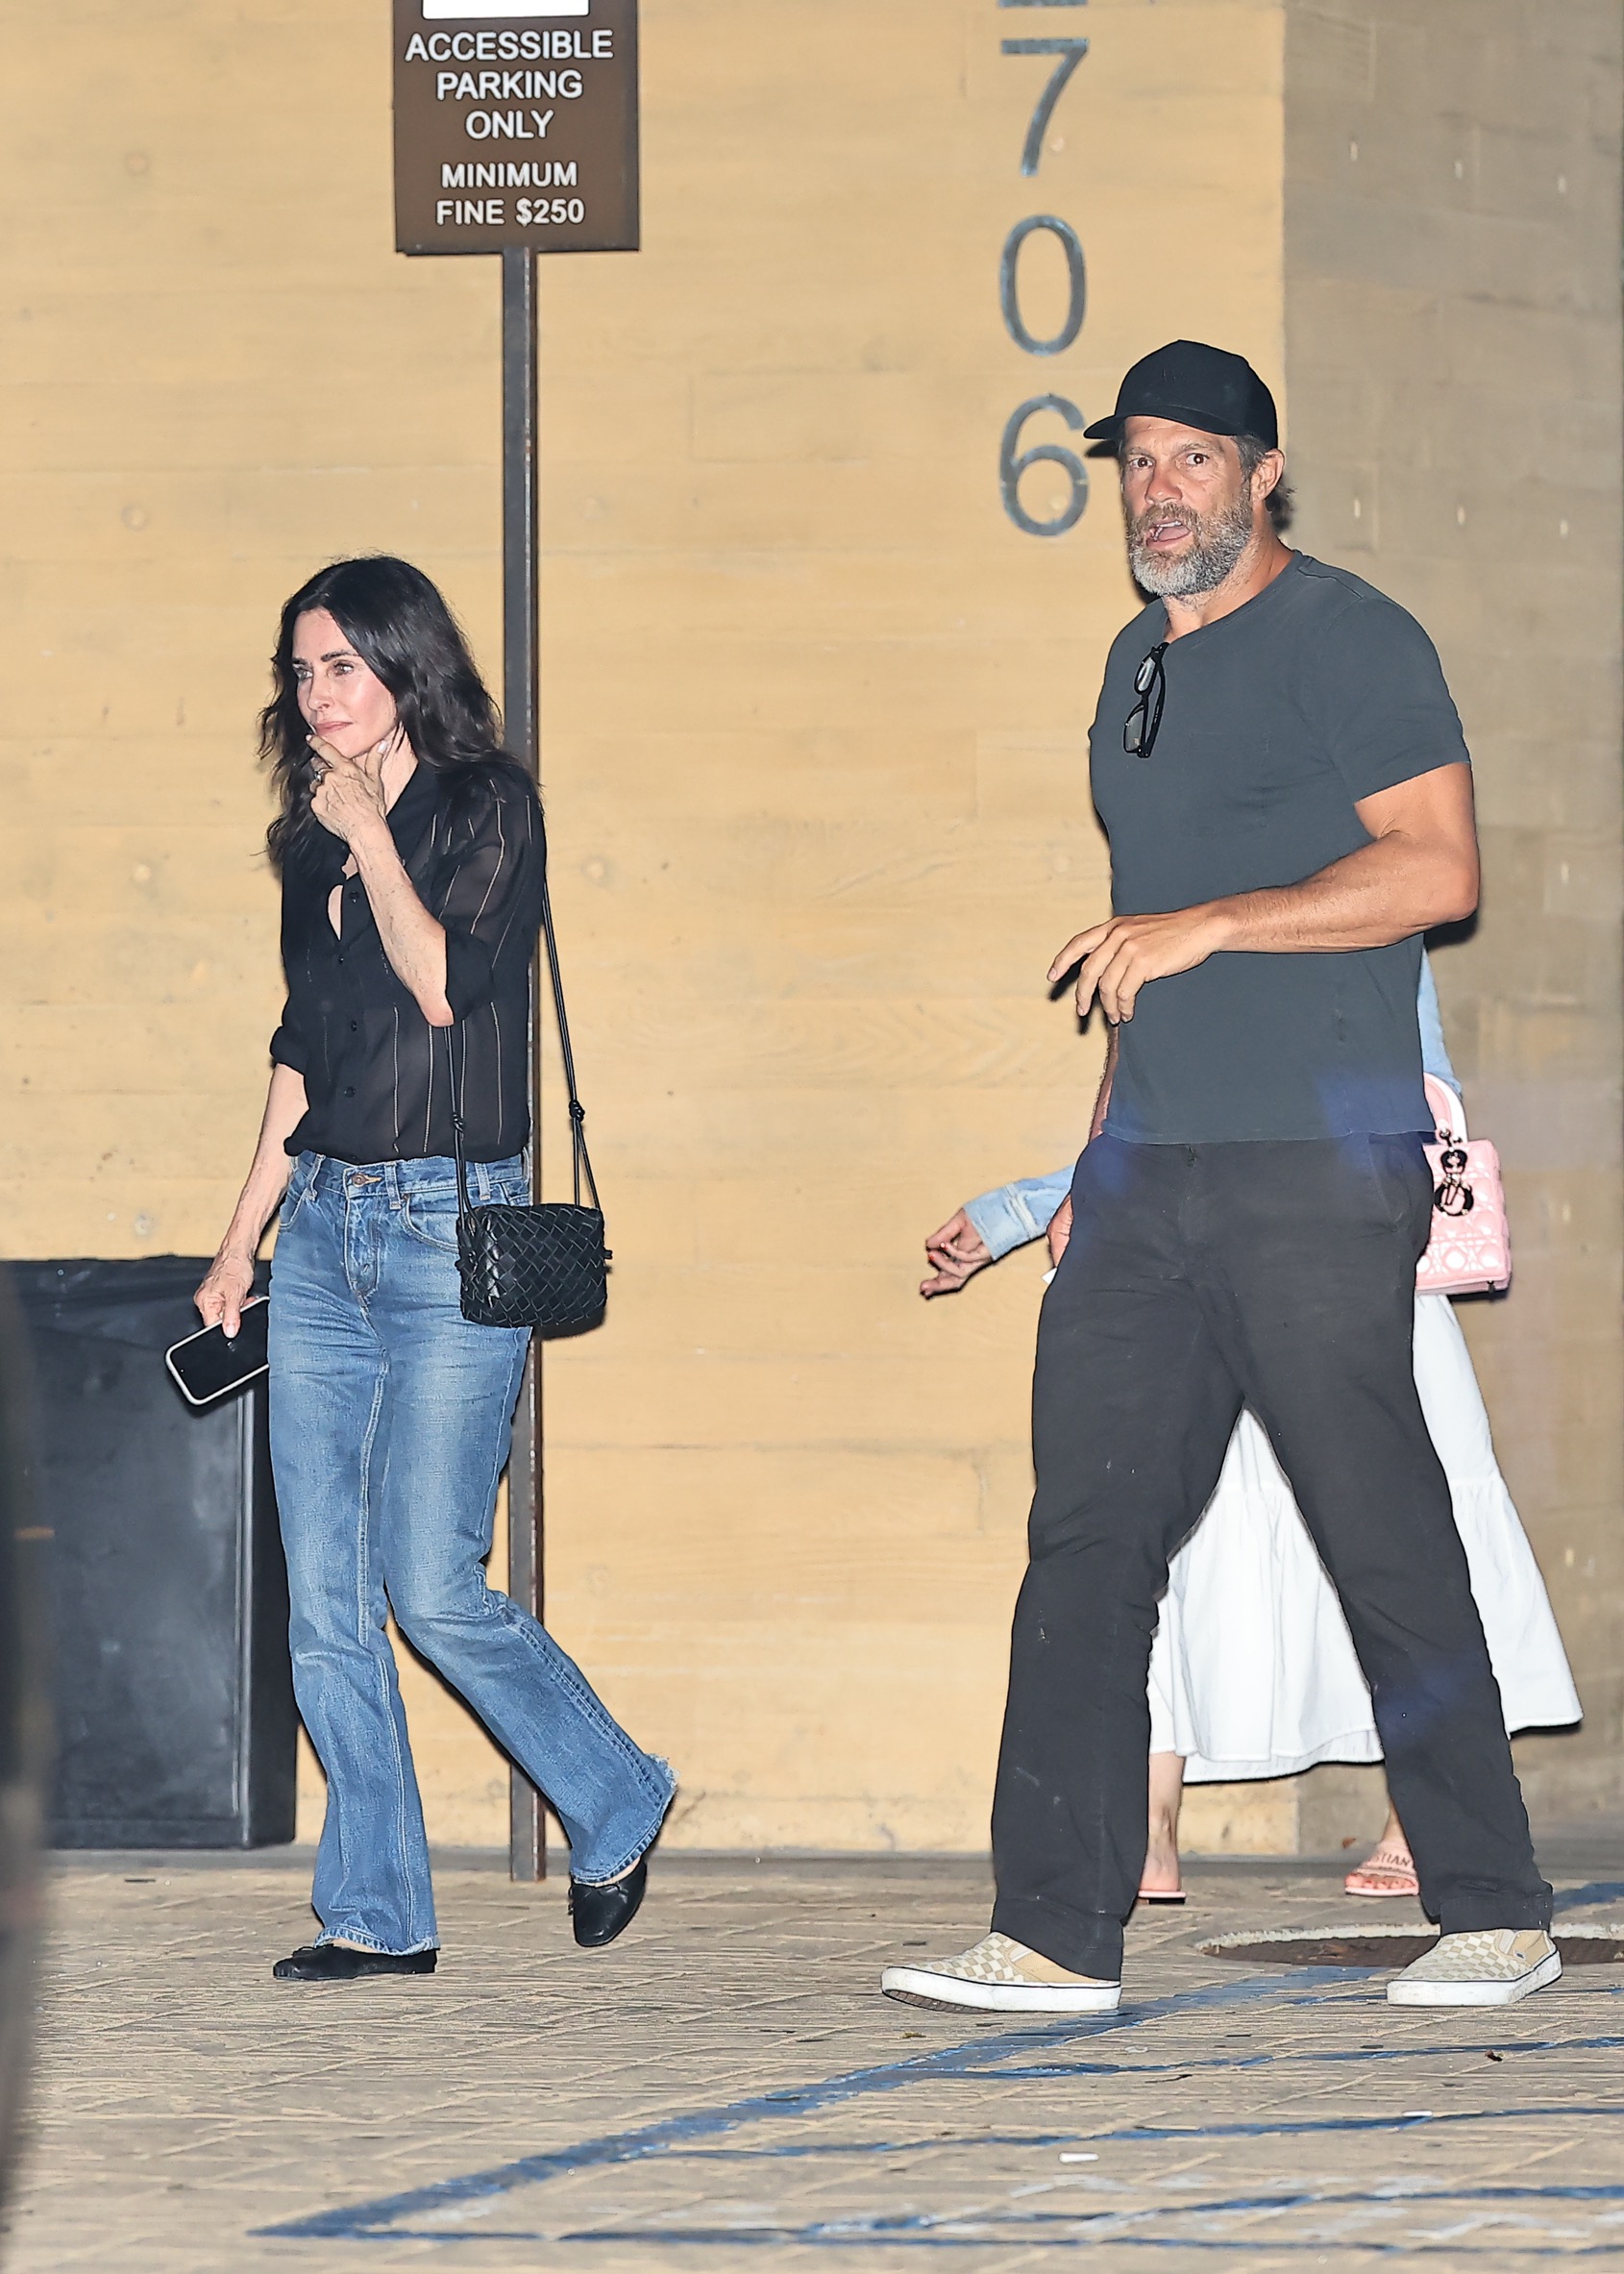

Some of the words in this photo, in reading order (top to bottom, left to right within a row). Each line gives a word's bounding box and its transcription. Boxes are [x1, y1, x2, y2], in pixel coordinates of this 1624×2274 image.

[404, 29, 614, 62] ACCESSIBLE
[436, 68, 583, 101] PARKING
[465, 109, 554, 140] ONLY
[441, 161, 578, 188] MINIMUM
[435, 198, 505, 226] FINE
[515, 196, 585, 228] $250
[997, 0, 1089, 537] 706
